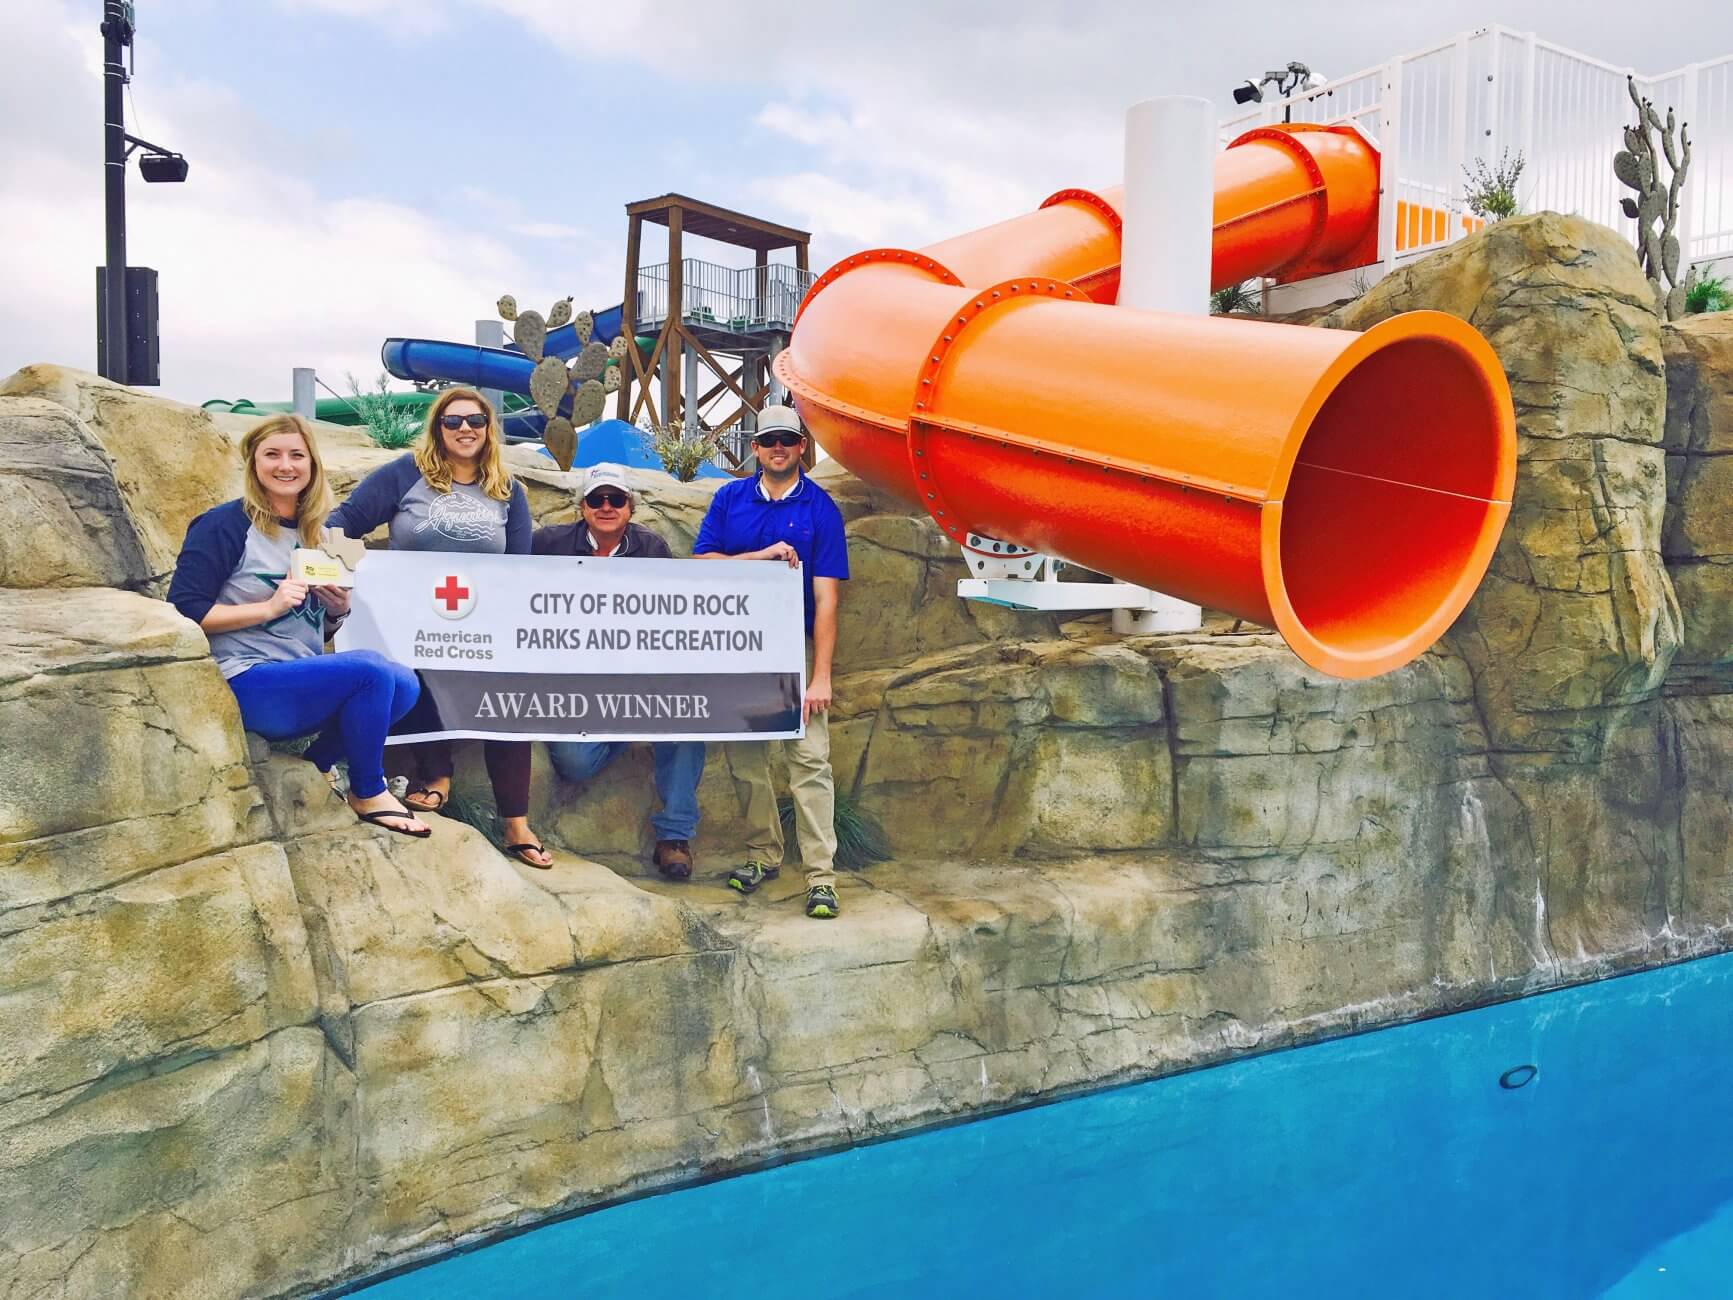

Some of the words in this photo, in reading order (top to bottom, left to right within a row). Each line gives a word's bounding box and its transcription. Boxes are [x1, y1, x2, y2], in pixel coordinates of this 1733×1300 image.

[530, 592, 575, 614] CITY
[579, 592, 607, 614] OF
[613, 593, 687, 615] ROUND
[693, 594, 749, 615] ROCK
[414, 629, 492, 644] American
[516, 628, 580, 650] PARKS
[586, 629, 631, 650] AND
[637, 630, 763, 651] RECREATION
[414, 645, 443, 658] Red
[447, 646, 493, 660] Cross
[475, 691, 588, 718] AWARD
[595, 694, 710, 719] WINNER
